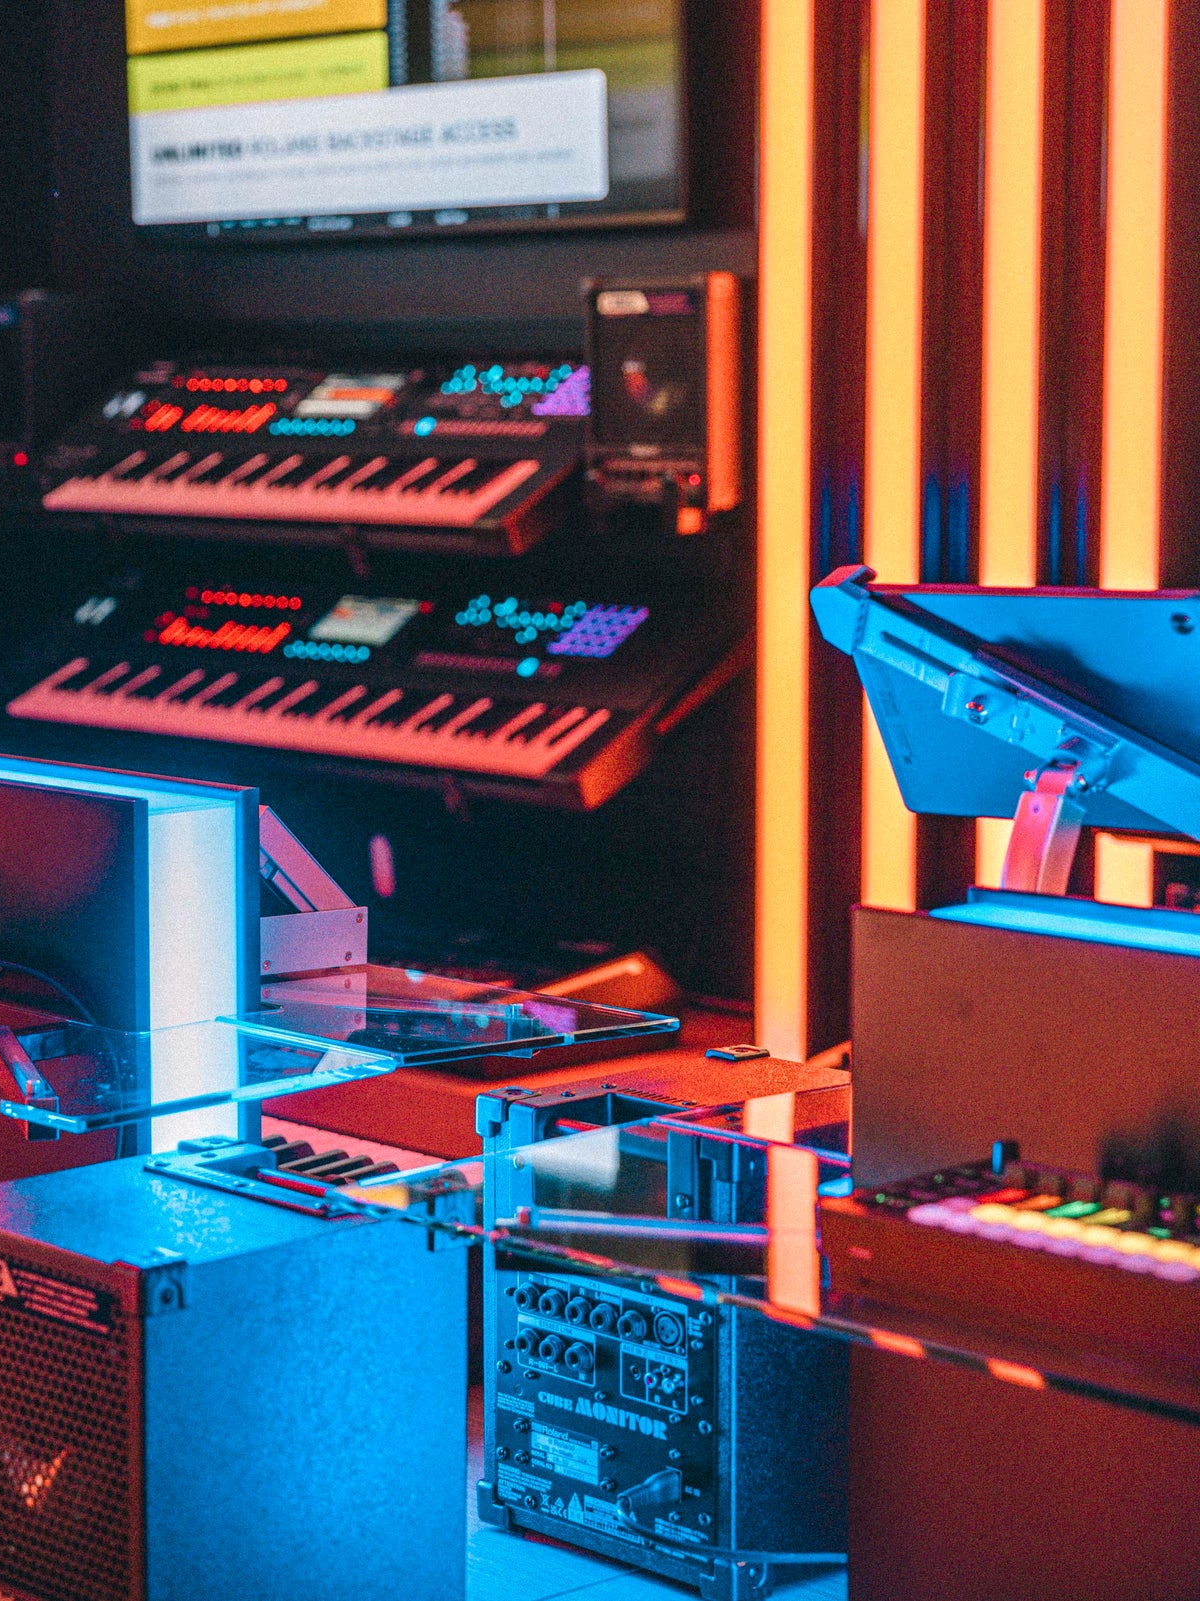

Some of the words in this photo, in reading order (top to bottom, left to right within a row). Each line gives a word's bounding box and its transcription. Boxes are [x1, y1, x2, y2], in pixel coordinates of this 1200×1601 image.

[538, 1391, 573, 1412] CUBE
[574, 1397, 668, 1441] MONITOR
[542, 1425, 569, 1441] Roland
